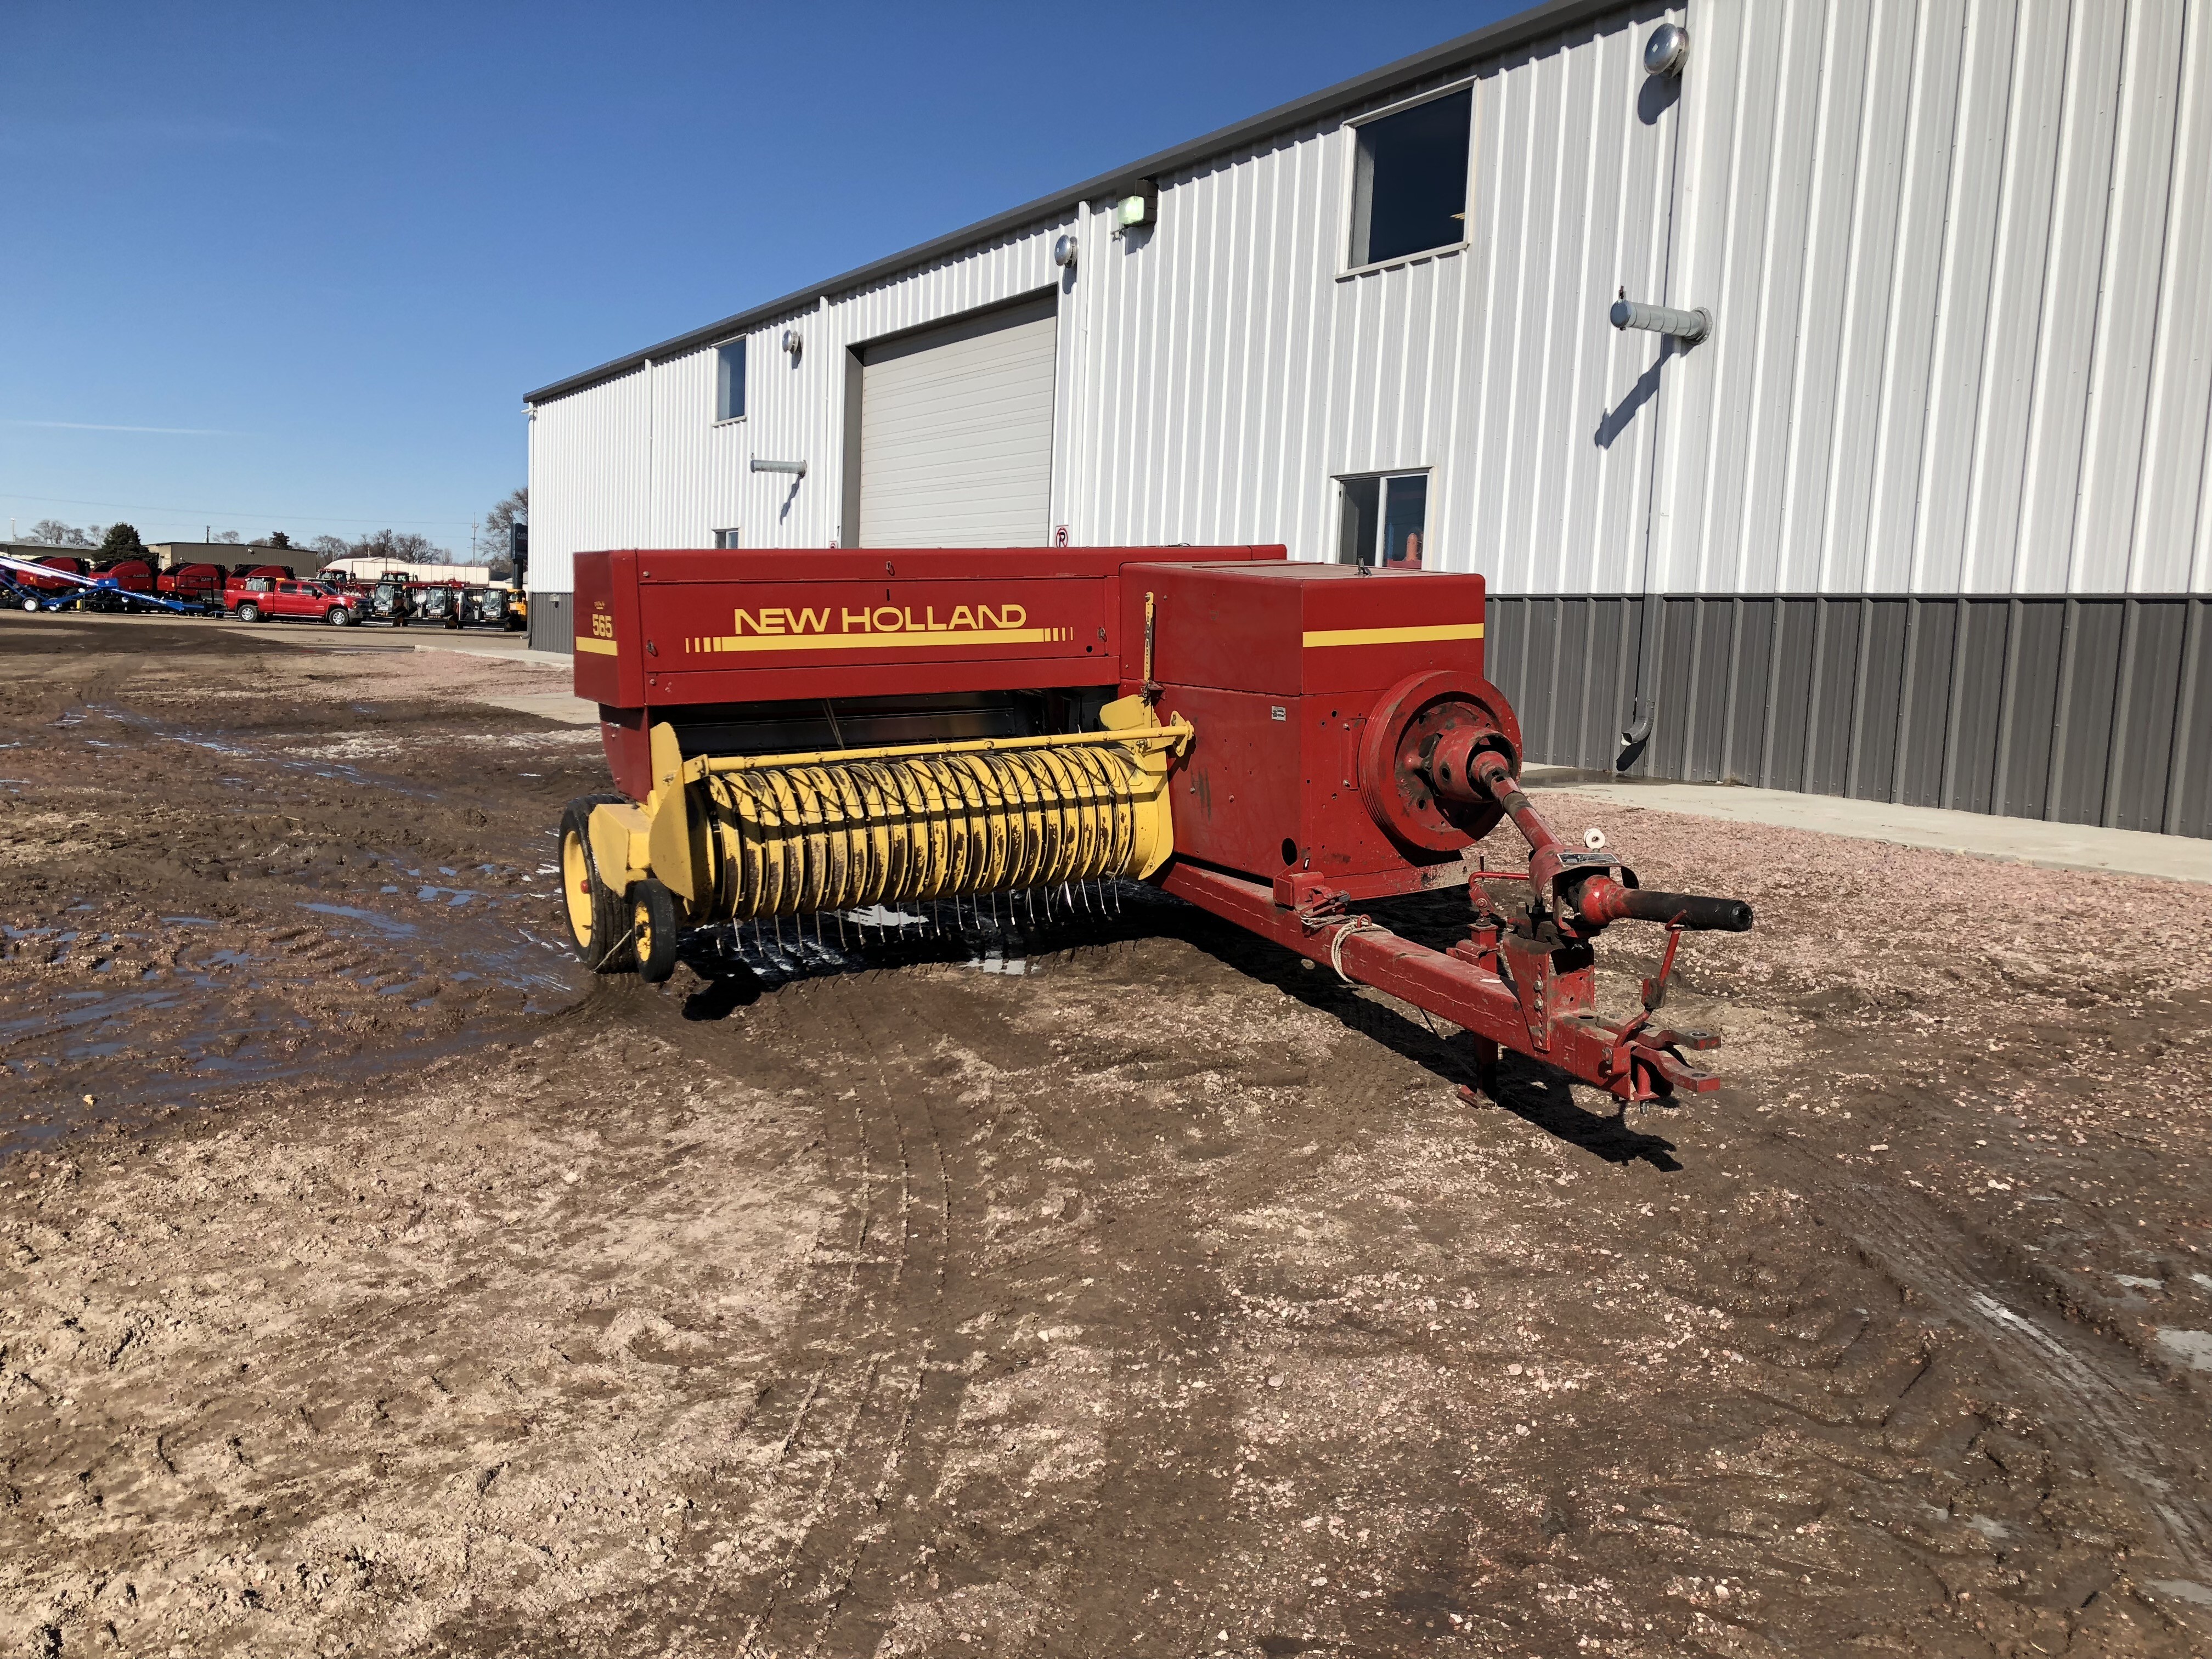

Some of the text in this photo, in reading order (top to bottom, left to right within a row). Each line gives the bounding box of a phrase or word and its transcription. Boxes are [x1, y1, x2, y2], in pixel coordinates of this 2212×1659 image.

[592, 613, 613, 638] 565
[734, 604, 1026, 634] NEW HOLLAND
